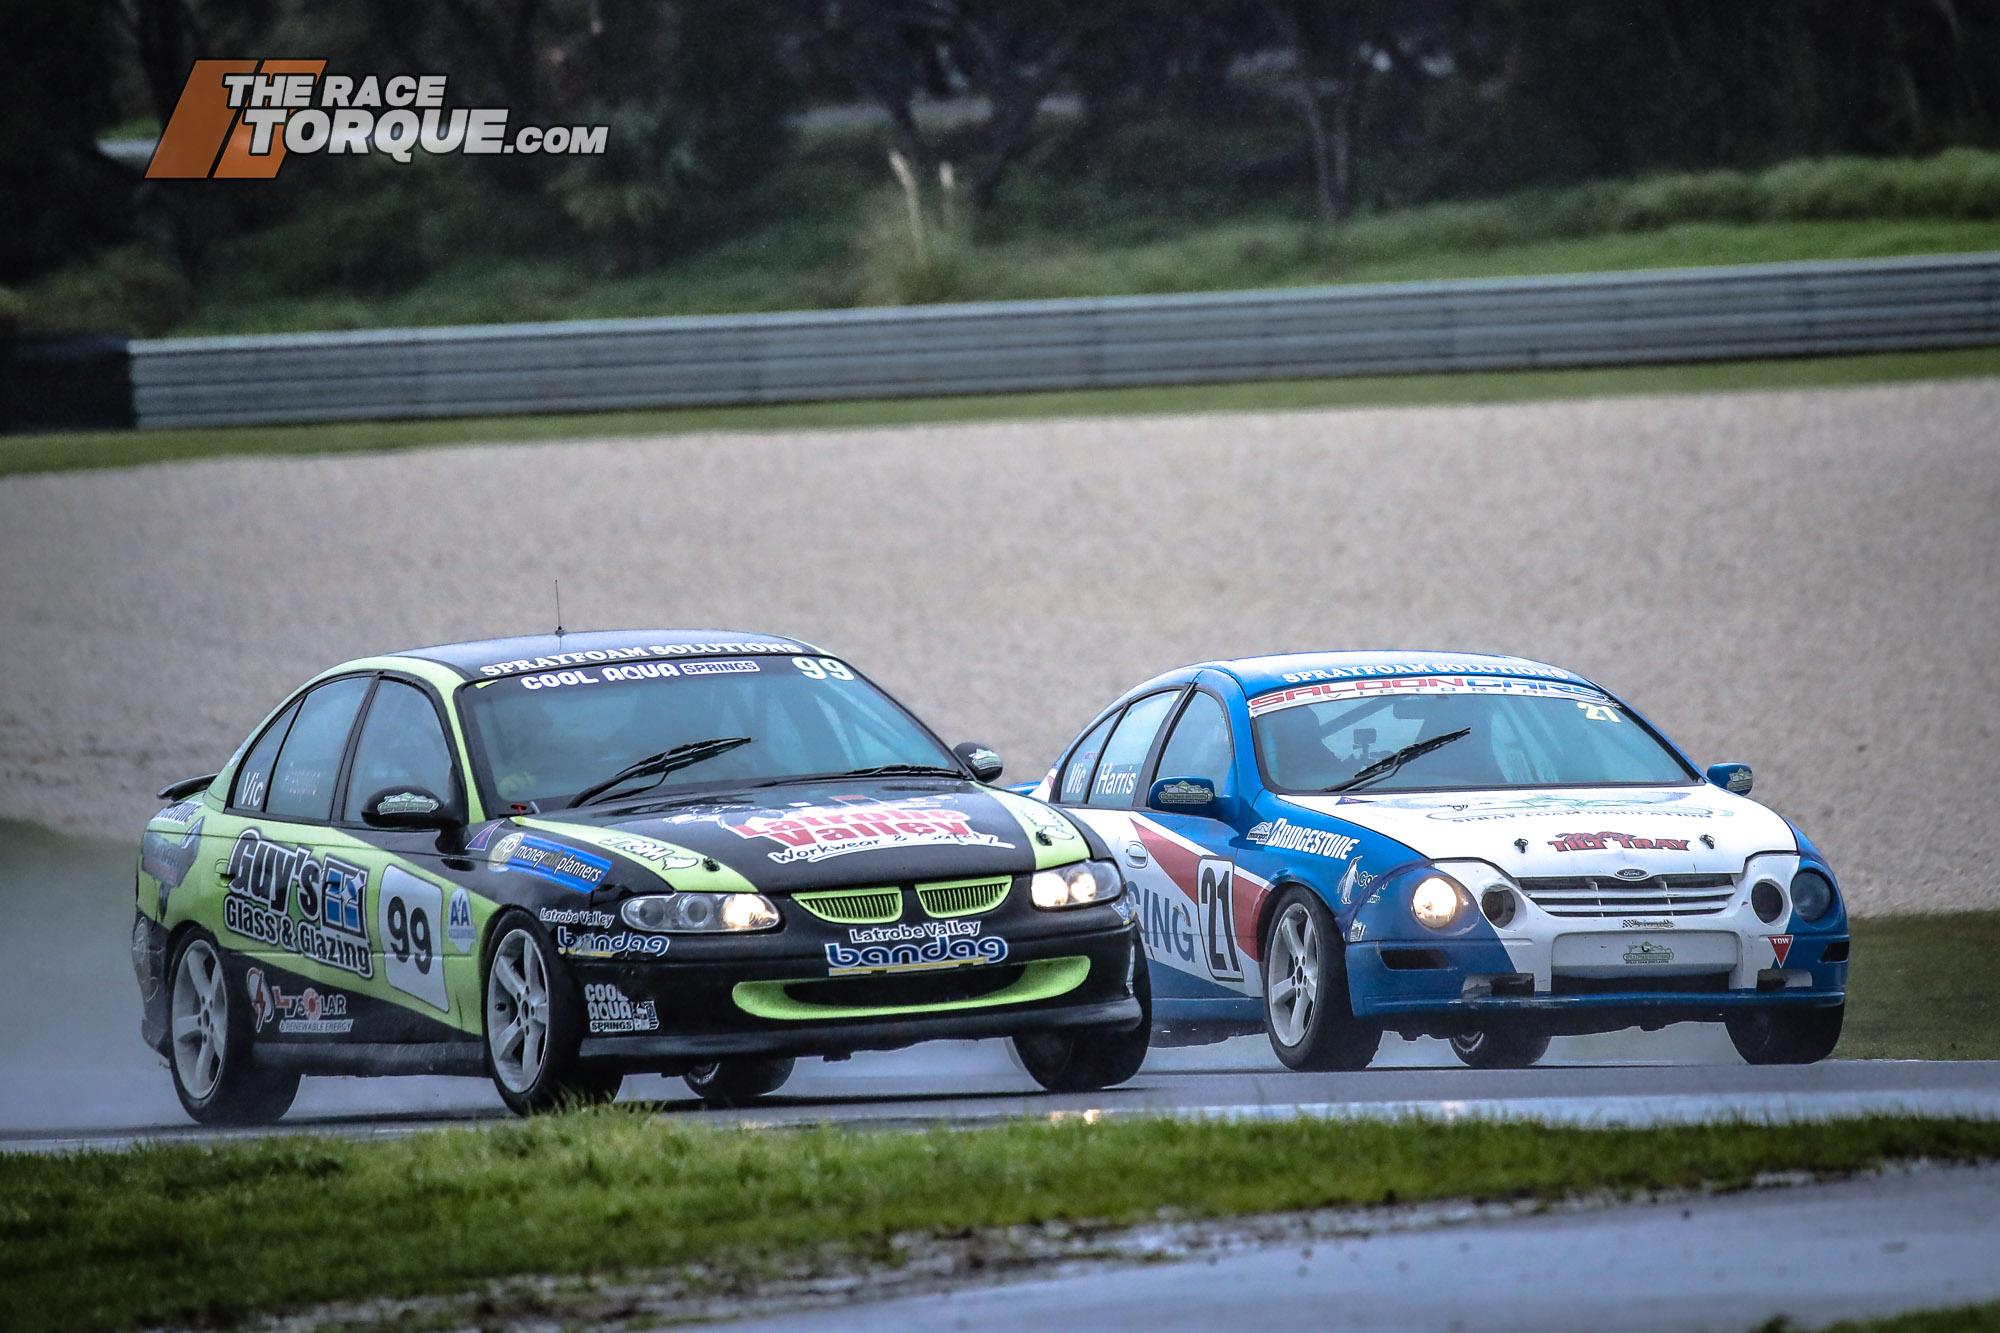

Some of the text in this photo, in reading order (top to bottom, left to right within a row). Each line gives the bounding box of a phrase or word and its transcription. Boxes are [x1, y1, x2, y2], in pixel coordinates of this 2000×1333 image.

[480, 641, 802, 677] SPRAYFOAM SOLUTIONS
[791, 655, 854, 681] 99
[520, 661, 758, 690] COOL AQUA SPRINGS
[1282, 663, 1569, 683] SPRAYFOAM SOLUTIONS
[1577, 702, 1621, 723] 21
[240, 771, 264, 807] Vic
[1066, 762, 1137, 795] Vic Harris
[732, 809, 966, 836] Latrobe
[768, 821, 970, 847] Valley
[773, 839, 880, 862] Workwear
[1266, 817, 1360, 861] BRIDGESTONE
[1547, 837, 1691, 853] TILT TRAY
[540, 908, 615, 928] Latrobe Valley
[1201, 867, 1241, 972] 21
[226, 897, 372, 977] Glass & Glazing
[387, 896, 432, 975] 99
[849, 920, 981, 944] Latrobe Valley
[1772, 937, 1789, 945] TOW
[825, 936, 1008, 968] bandag
[588, 1001, 632, 1020] AQUA
[591, 1021, 632, 1031] SPRINGS
